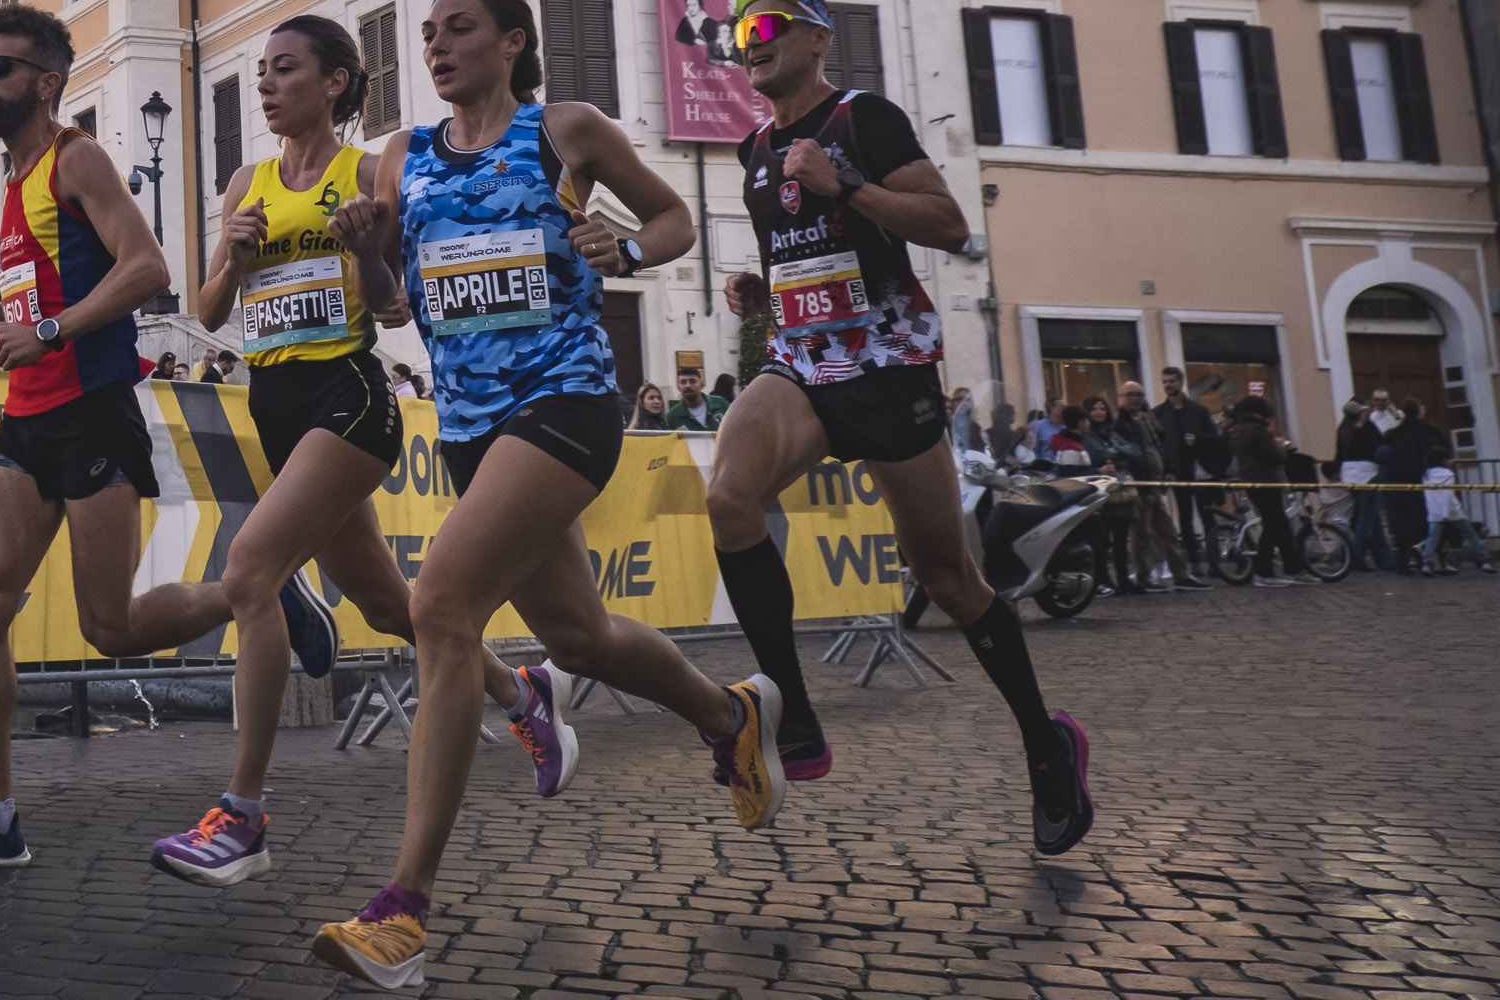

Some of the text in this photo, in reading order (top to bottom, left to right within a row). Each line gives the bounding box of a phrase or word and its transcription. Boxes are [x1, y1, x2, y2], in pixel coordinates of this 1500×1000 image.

[473, 175, 532, 192] ESERCITO
[440, 242, 470, 253] mooney
[440, 246, 512, 261] WERUNROME
[260, 271, 315, 287] WERUNROME
[443, 269, 526, 310] APRILE
[257, 290, 326, 329] FASCETTI
[476, 306, 487, 314] F2
[794, 290, 833, 317] 785
